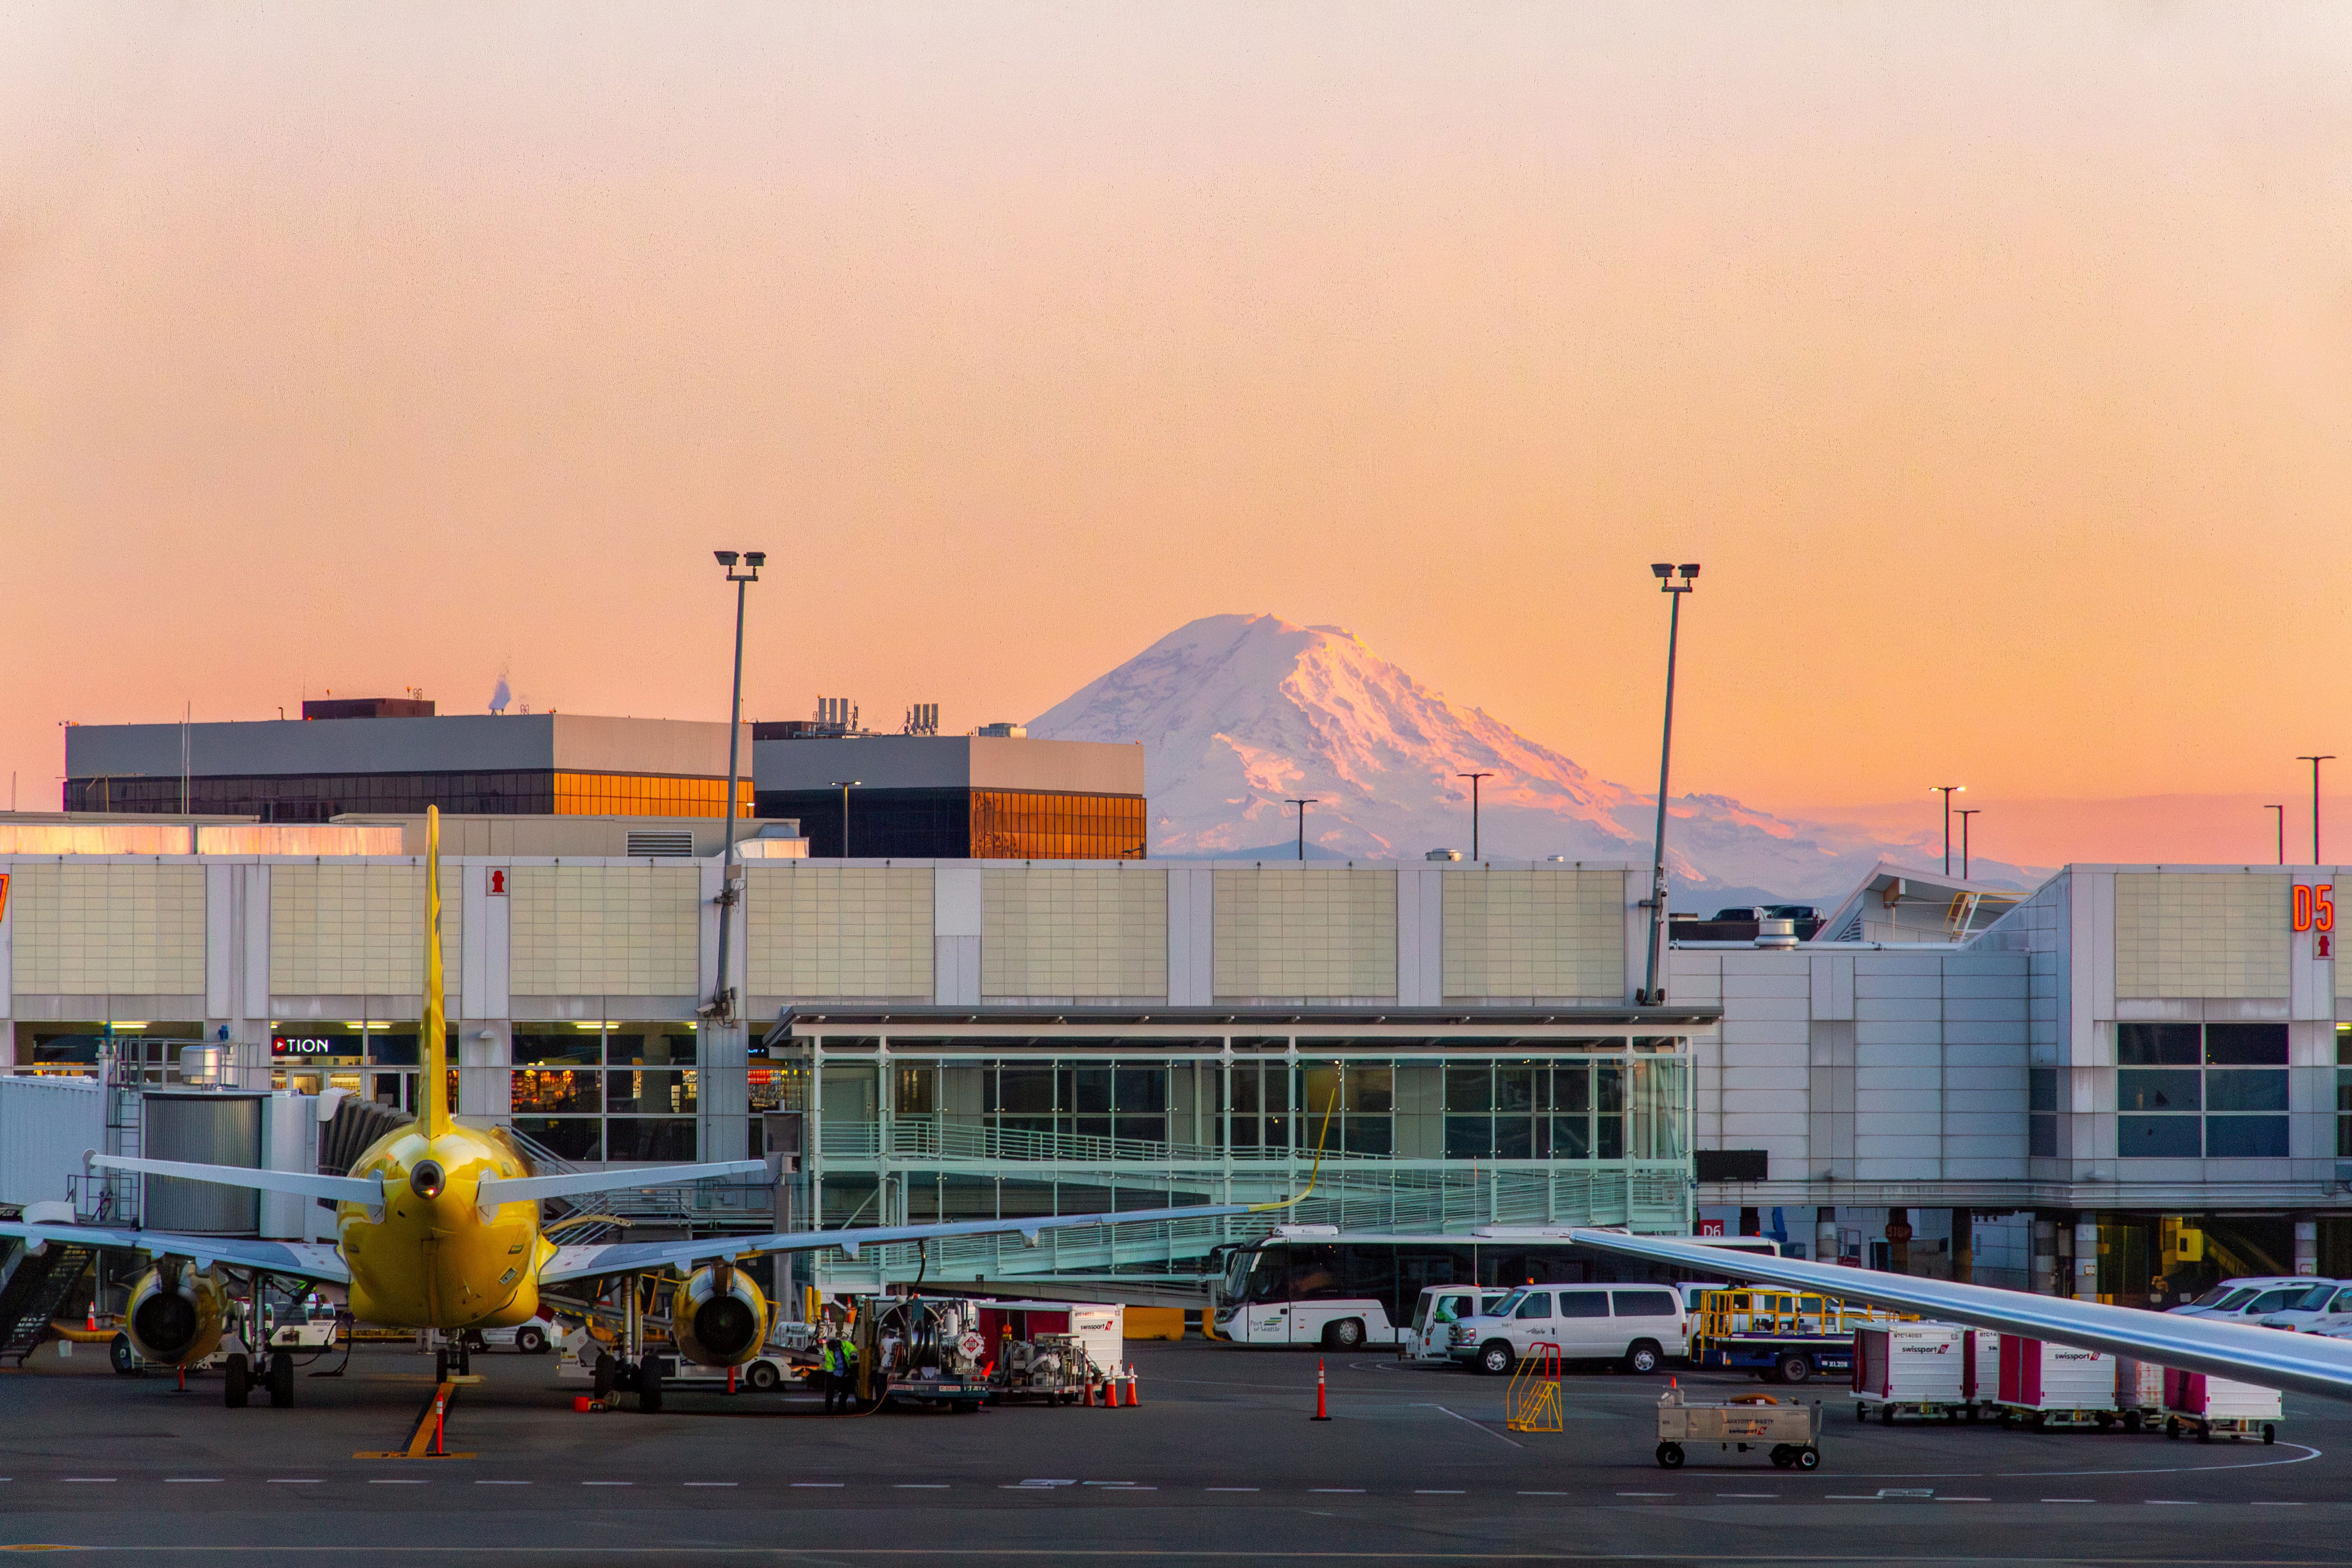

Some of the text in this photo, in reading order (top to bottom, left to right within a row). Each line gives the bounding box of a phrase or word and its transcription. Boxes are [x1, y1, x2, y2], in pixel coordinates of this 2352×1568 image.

[2293, 885, 2333, 931] D5
[1704, 1225, 1721, 1236] D6
[1902, 1345, 1937, 1354] swissport
[2055, 1352, 2090, 1361] swissport
